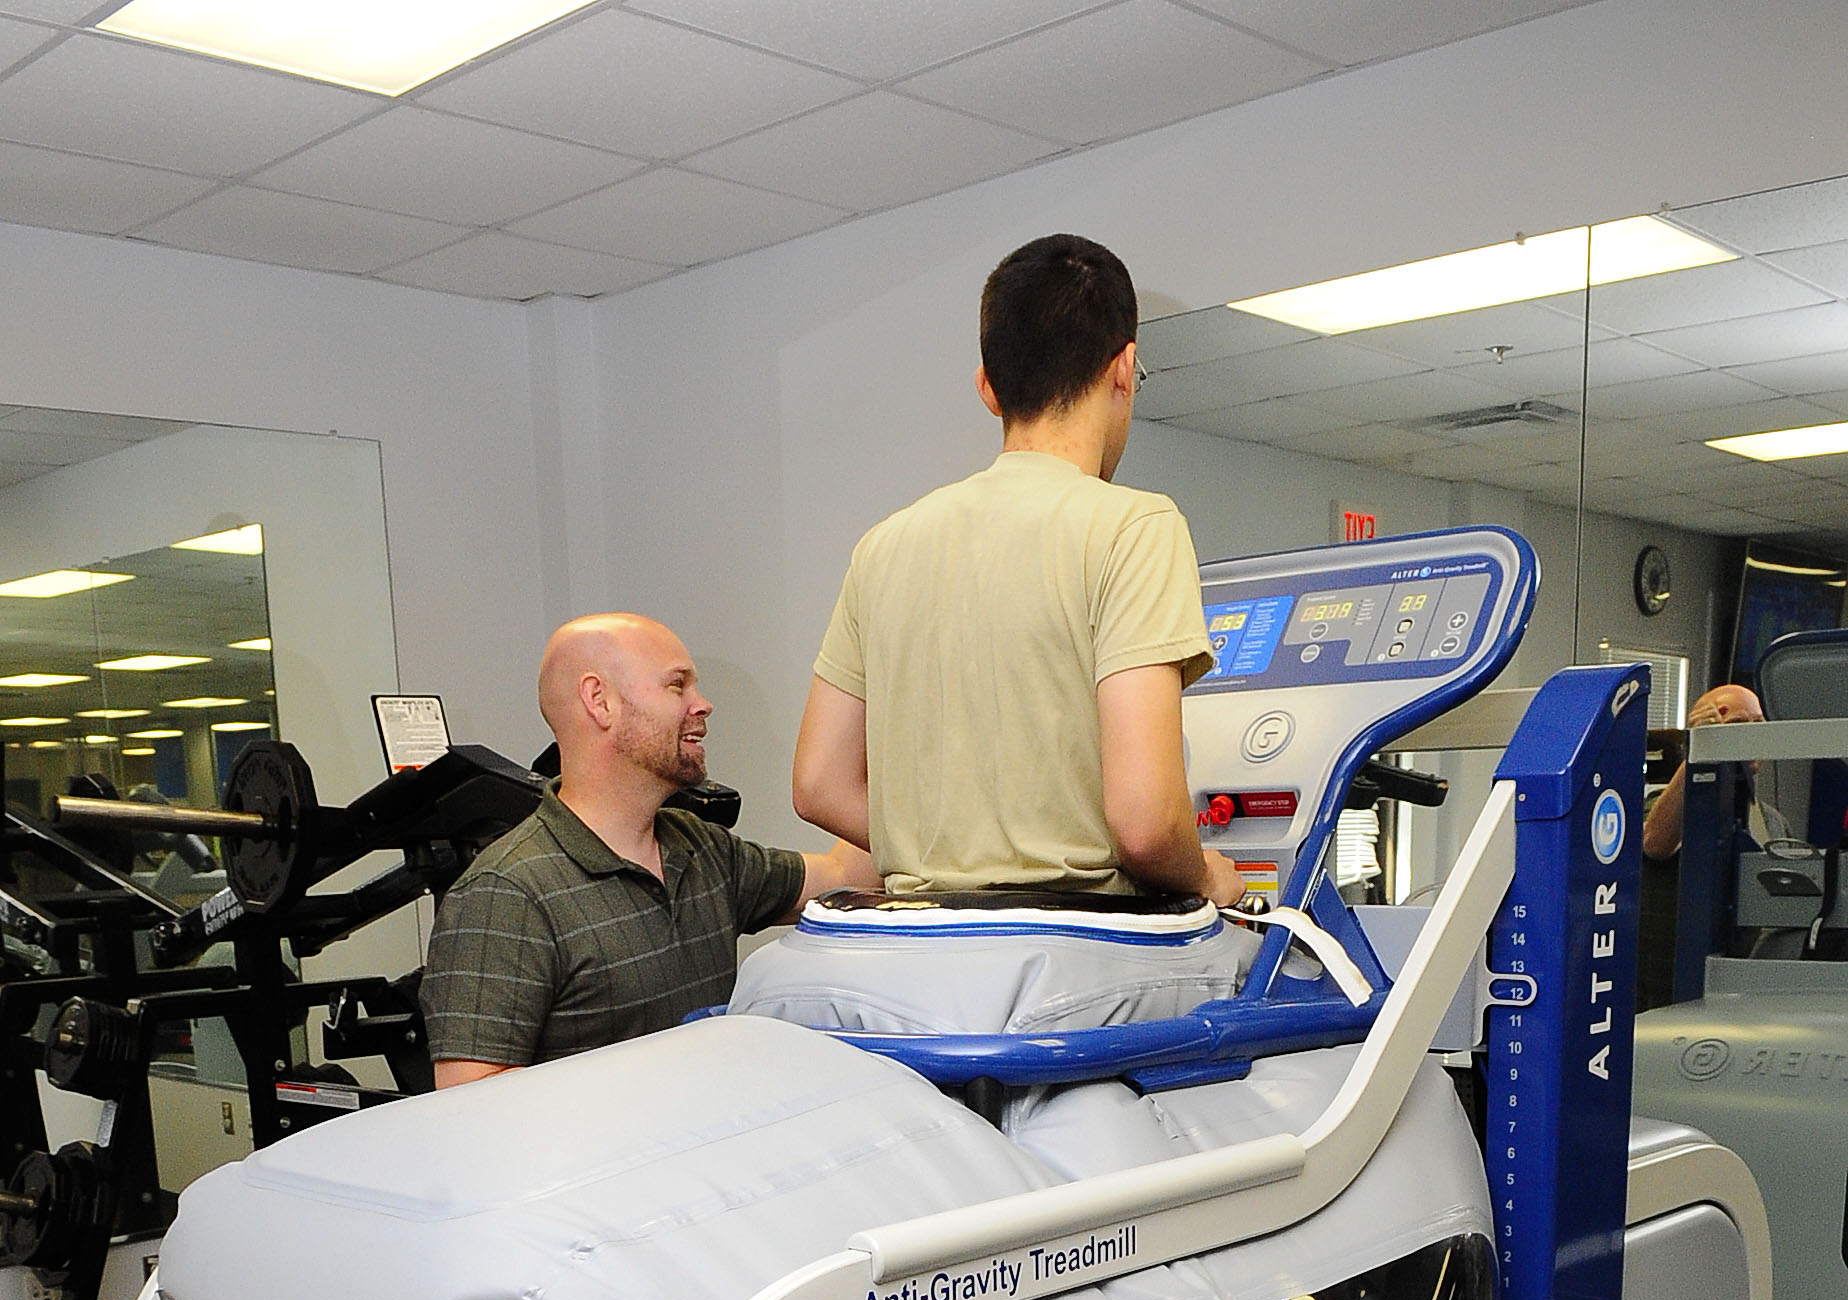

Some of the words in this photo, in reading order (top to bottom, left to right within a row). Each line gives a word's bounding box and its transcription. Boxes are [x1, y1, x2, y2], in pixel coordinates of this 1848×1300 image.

[1391, 569, 1419, 579] ALTER
[1512, 905, 1527, 918] 15
[1511, 932, 1526, 946] 14
[1510, 960, 1525, 973] 13
[1588, 881, 1617, 1080] ALTER
[1510, 987, 1524, 1000] 12
[1509, 1014, 1522, 1027] 11
[1508, 1041, 1522, 1054] 10
[1510, 1068, 1518, 1080] 9
[1509, 1095, 1517, 1107] 8
[1508, 1121, 1516, 1133] 7
[1507, 1147, 1515, 1159] 6
[1506, 1173, 1514, 1185] 5
[1505, 1199, 1514, 1211] 4
[1504, 1225, 1512, 1237] 3
[1029, 1225, 1137, 1281] Treadmill
[1504, 1251, 1511, 1262] 2
